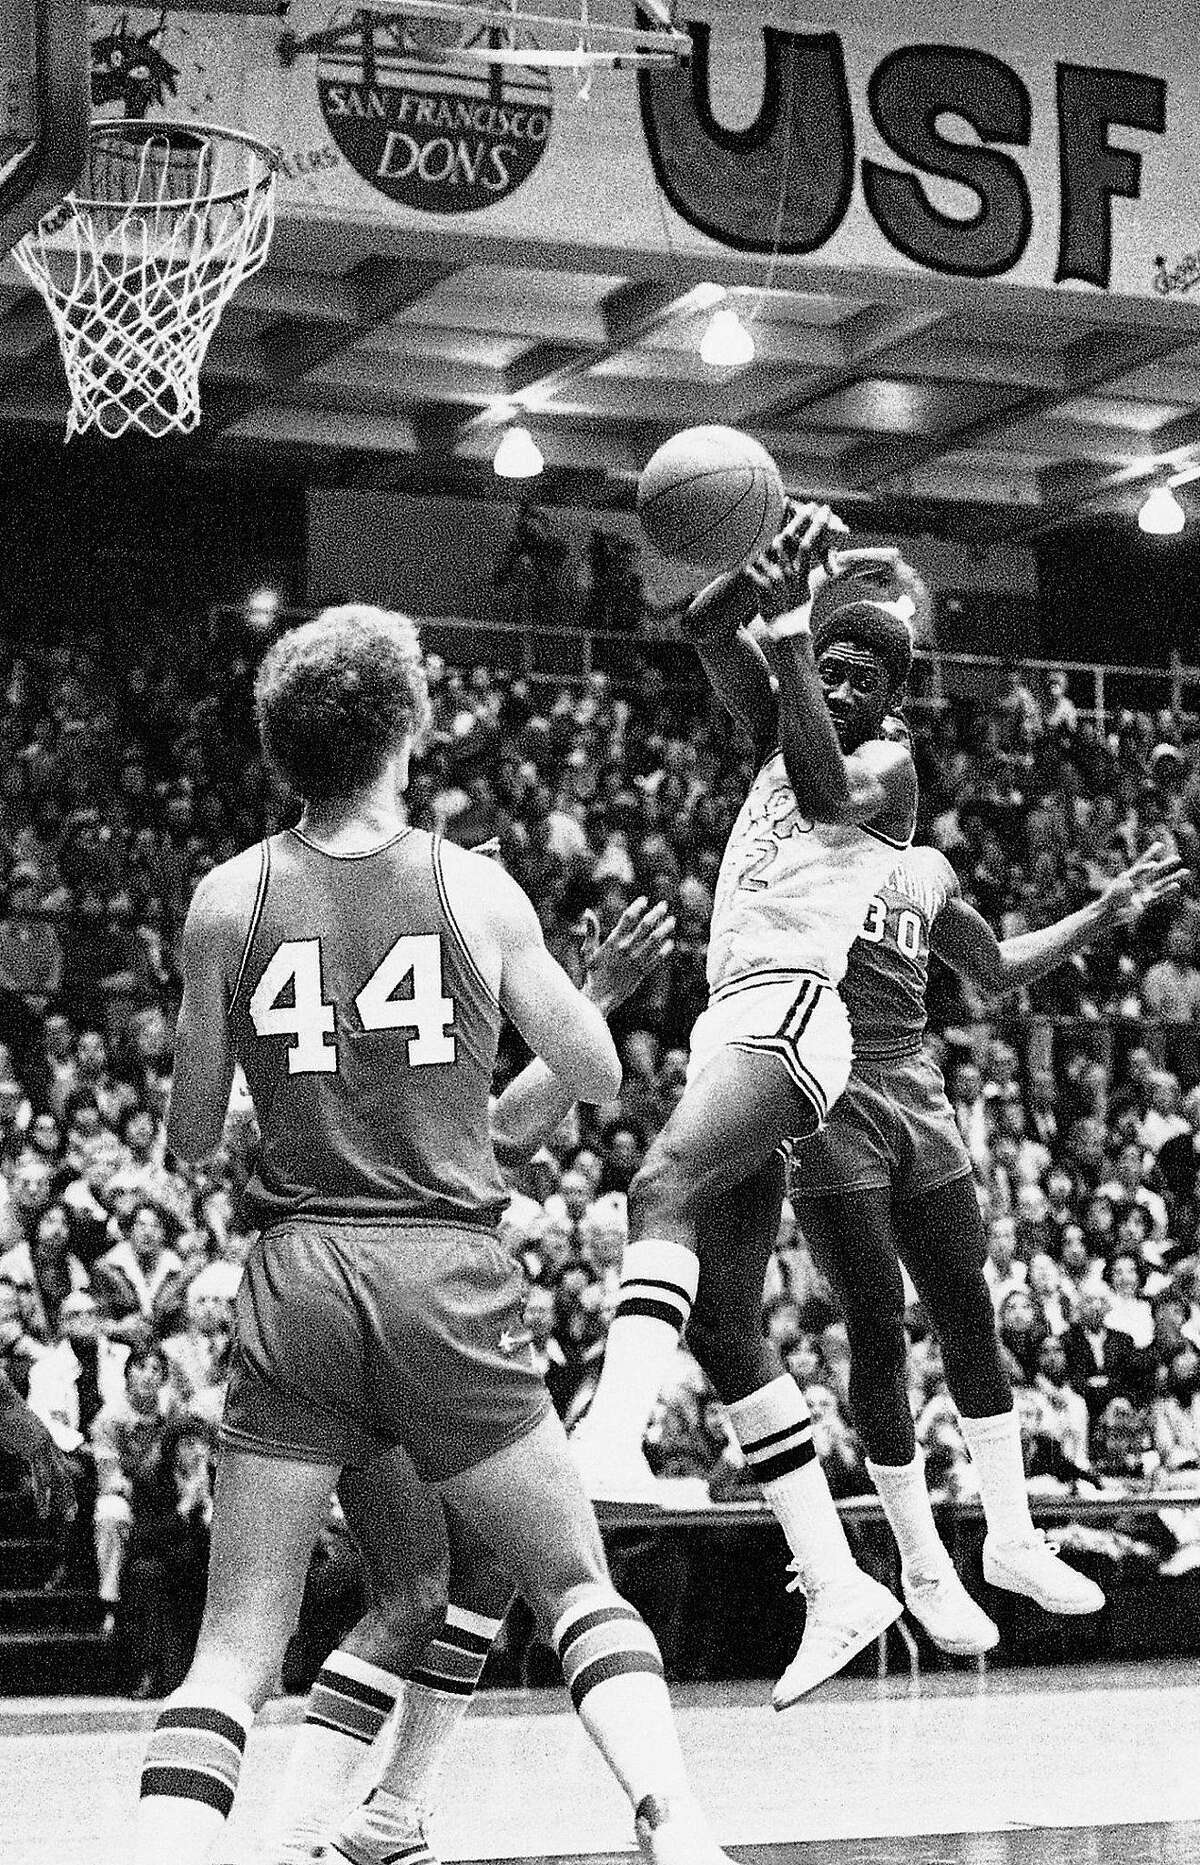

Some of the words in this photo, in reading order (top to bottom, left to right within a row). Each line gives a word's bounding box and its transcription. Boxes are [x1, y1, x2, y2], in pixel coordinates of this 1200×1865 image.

[326, 87, 387, 119] SAN
[397, 93, 550, 141] FRANCISCO
[377, 130, 518, 191] DONS
[636, 8, 1168, 290] USF
[858, 896, 922, 960] 30
[249, 933, 456, 1074] 44
